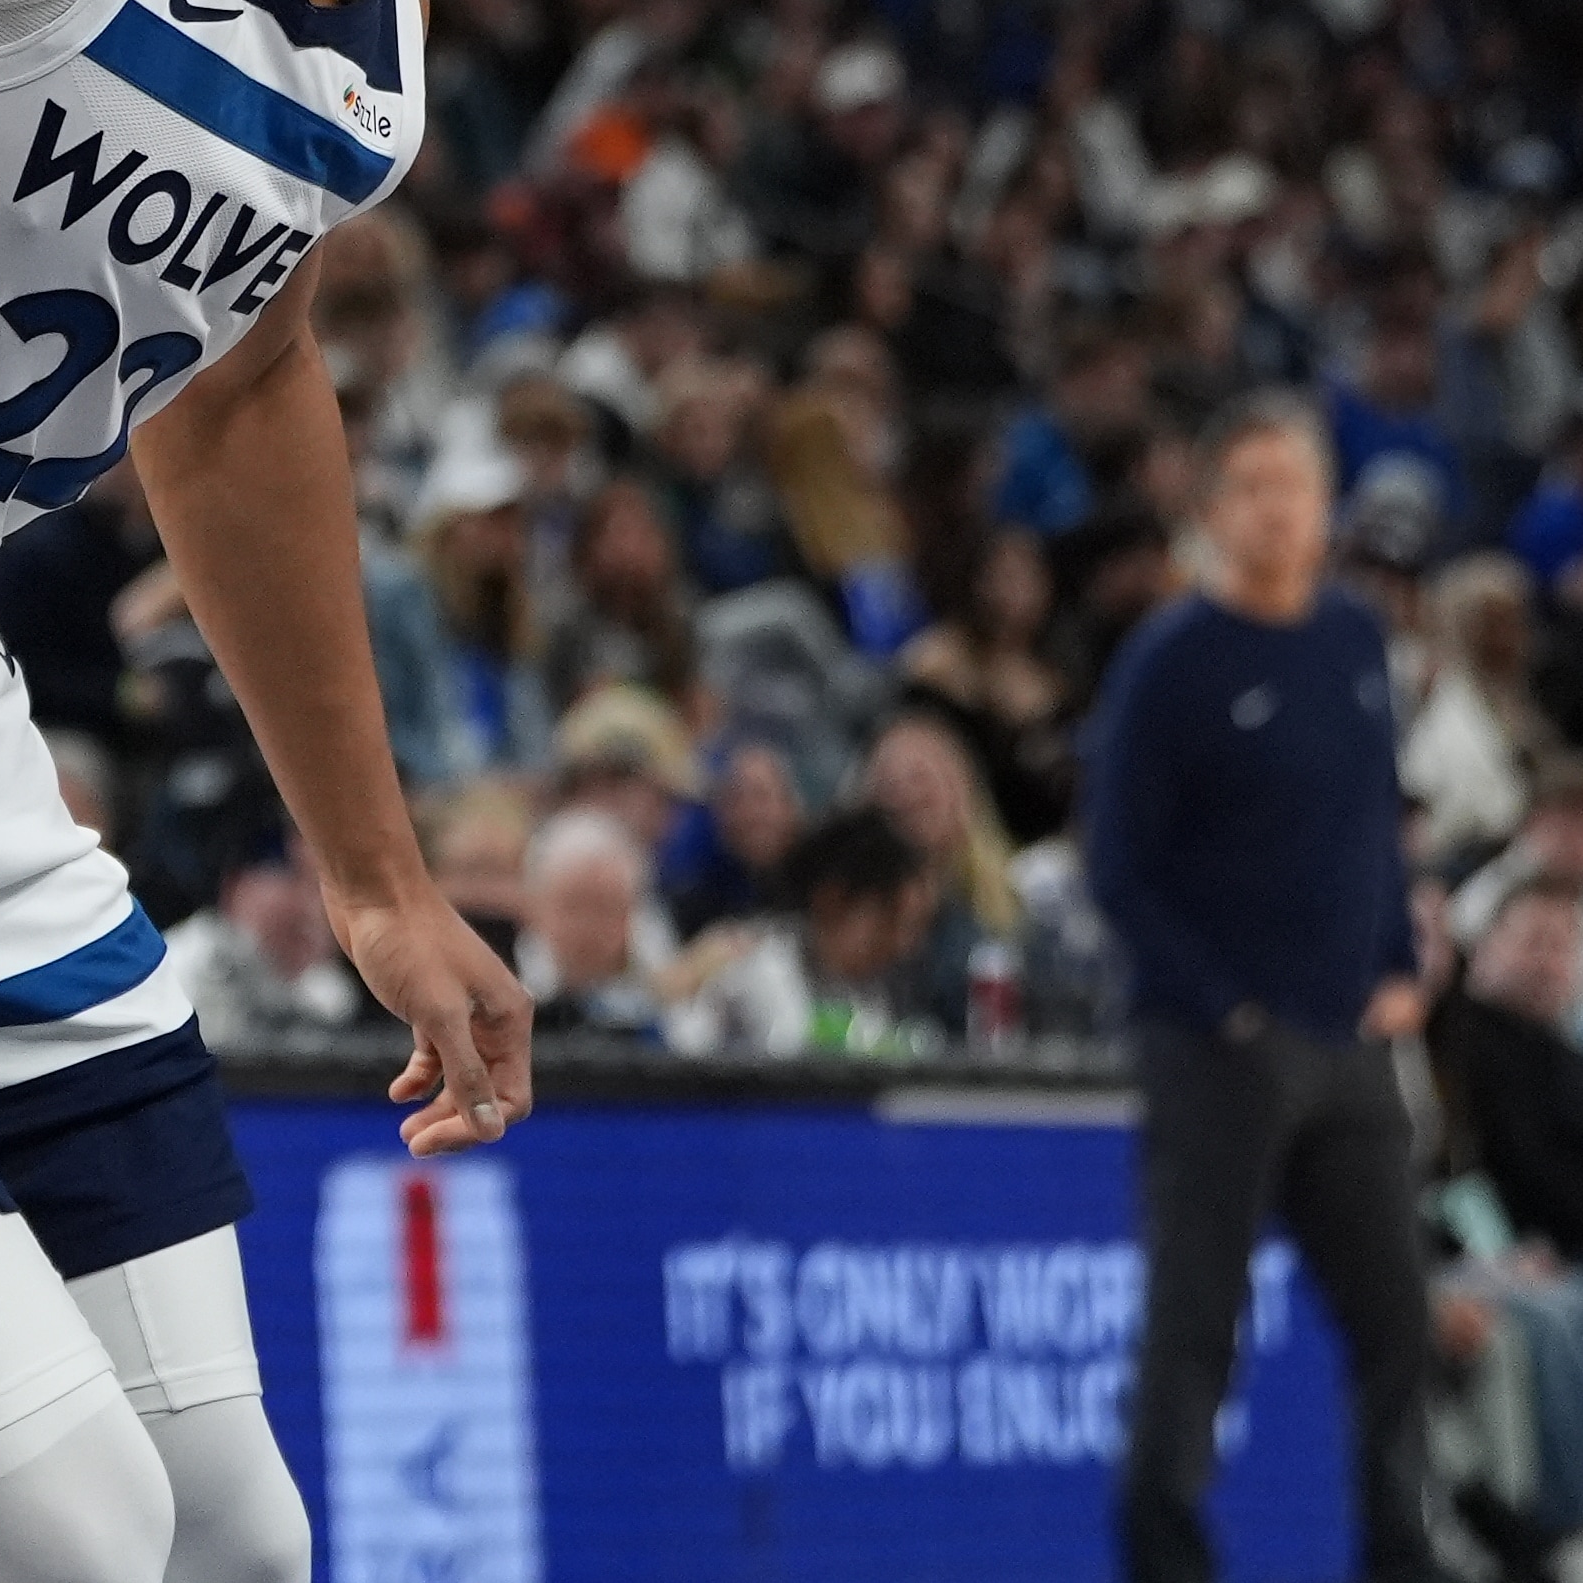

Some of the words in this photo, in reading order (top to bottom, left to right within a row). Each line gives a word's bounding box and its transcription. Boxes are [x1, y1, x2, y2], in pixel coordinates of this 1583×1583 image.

[13, 98, 313, 315] WOLVE
[796, 1239, 979, 1358] ONLY
[979, 1239, 1149, 1358] WOR
[799, 1359, 953, 1468] YOU
